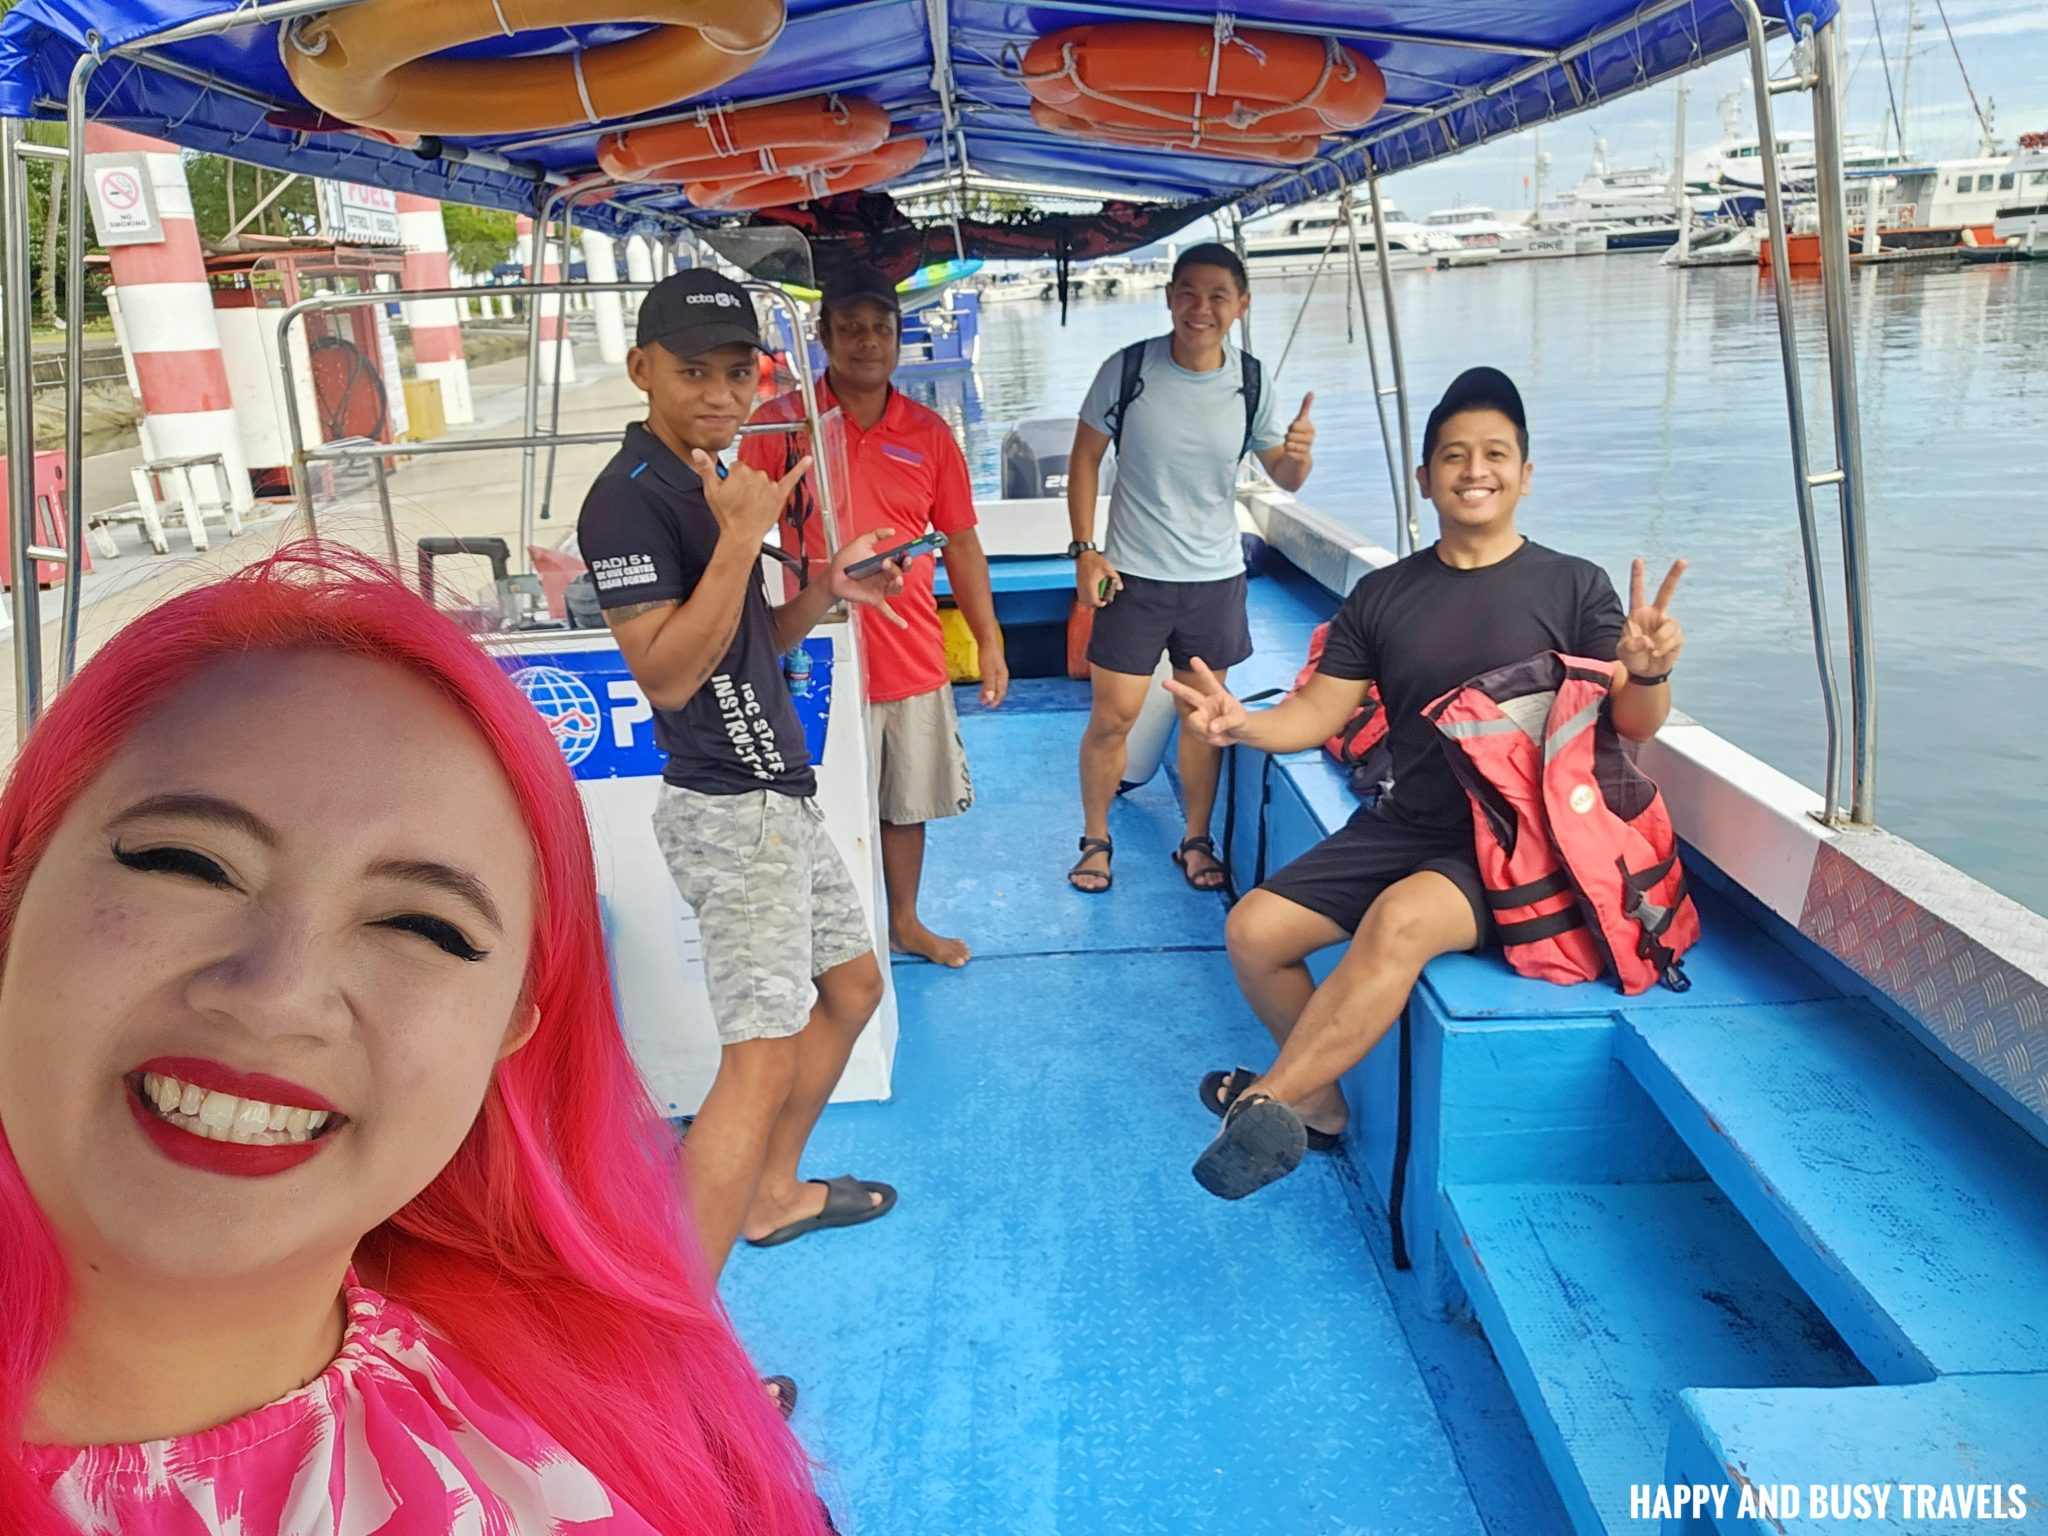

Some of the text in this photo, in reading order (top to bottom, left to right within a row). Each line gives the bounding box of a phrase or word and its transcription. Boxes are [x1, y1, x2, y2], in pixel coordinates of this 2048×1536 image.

[109, 220, 147, 228] SMOKING
[592, 554, 641, 571] PADI 5
[753, 718, 785, 773] STAFF
